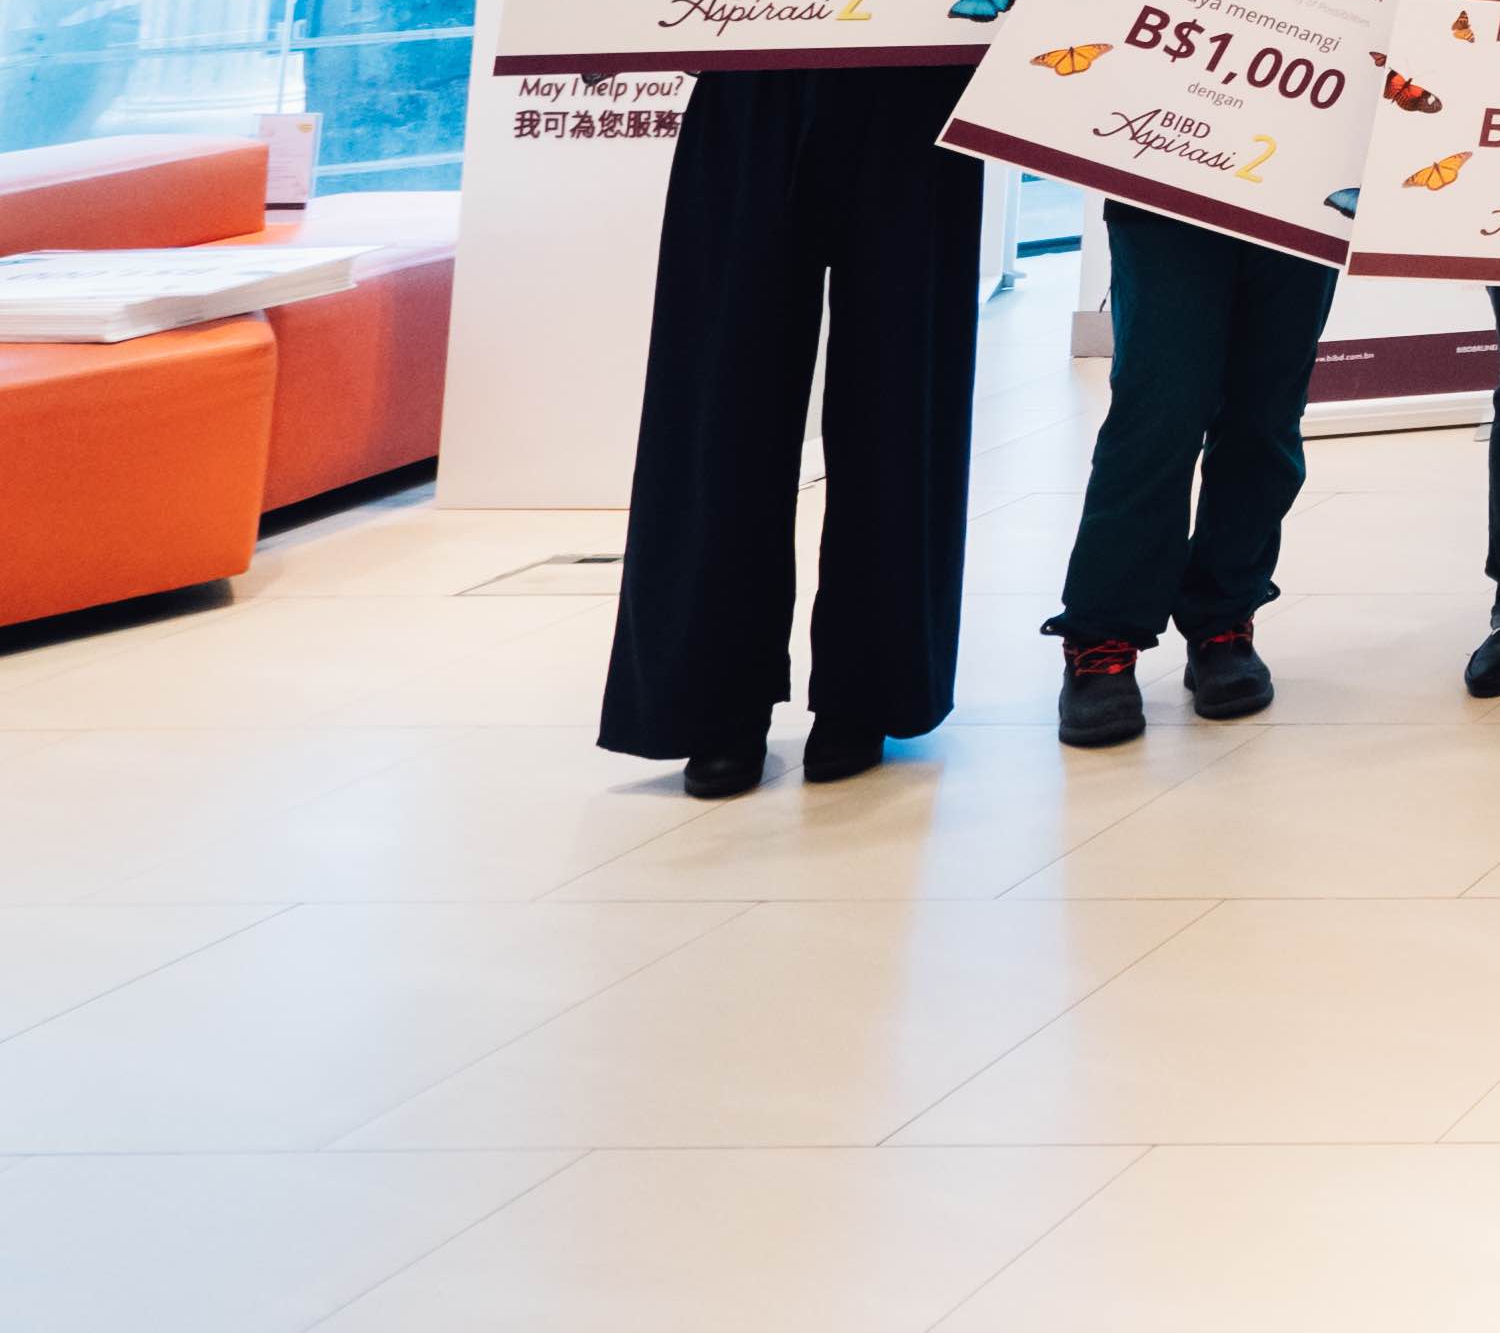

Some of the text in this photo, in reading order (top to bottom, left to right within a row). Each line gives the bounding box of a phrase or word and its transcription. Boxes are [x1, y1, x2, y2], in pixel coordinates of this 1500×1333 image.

[1225, 3, 1340, 54] memenangi
[1124, 4, 1346, 110] B$1,000
[519, 78, 566, 102] May
[584, 77, 627, 102] help
[632, 76, 684, 102] you?
[1186, 81, 1245, 109] dengan
[514, 109, 683, 139] 我可為您服務
[1160, 110, 1211, 139] BIBD
[1092, 108, 1278, 185] Aspirasi 2
